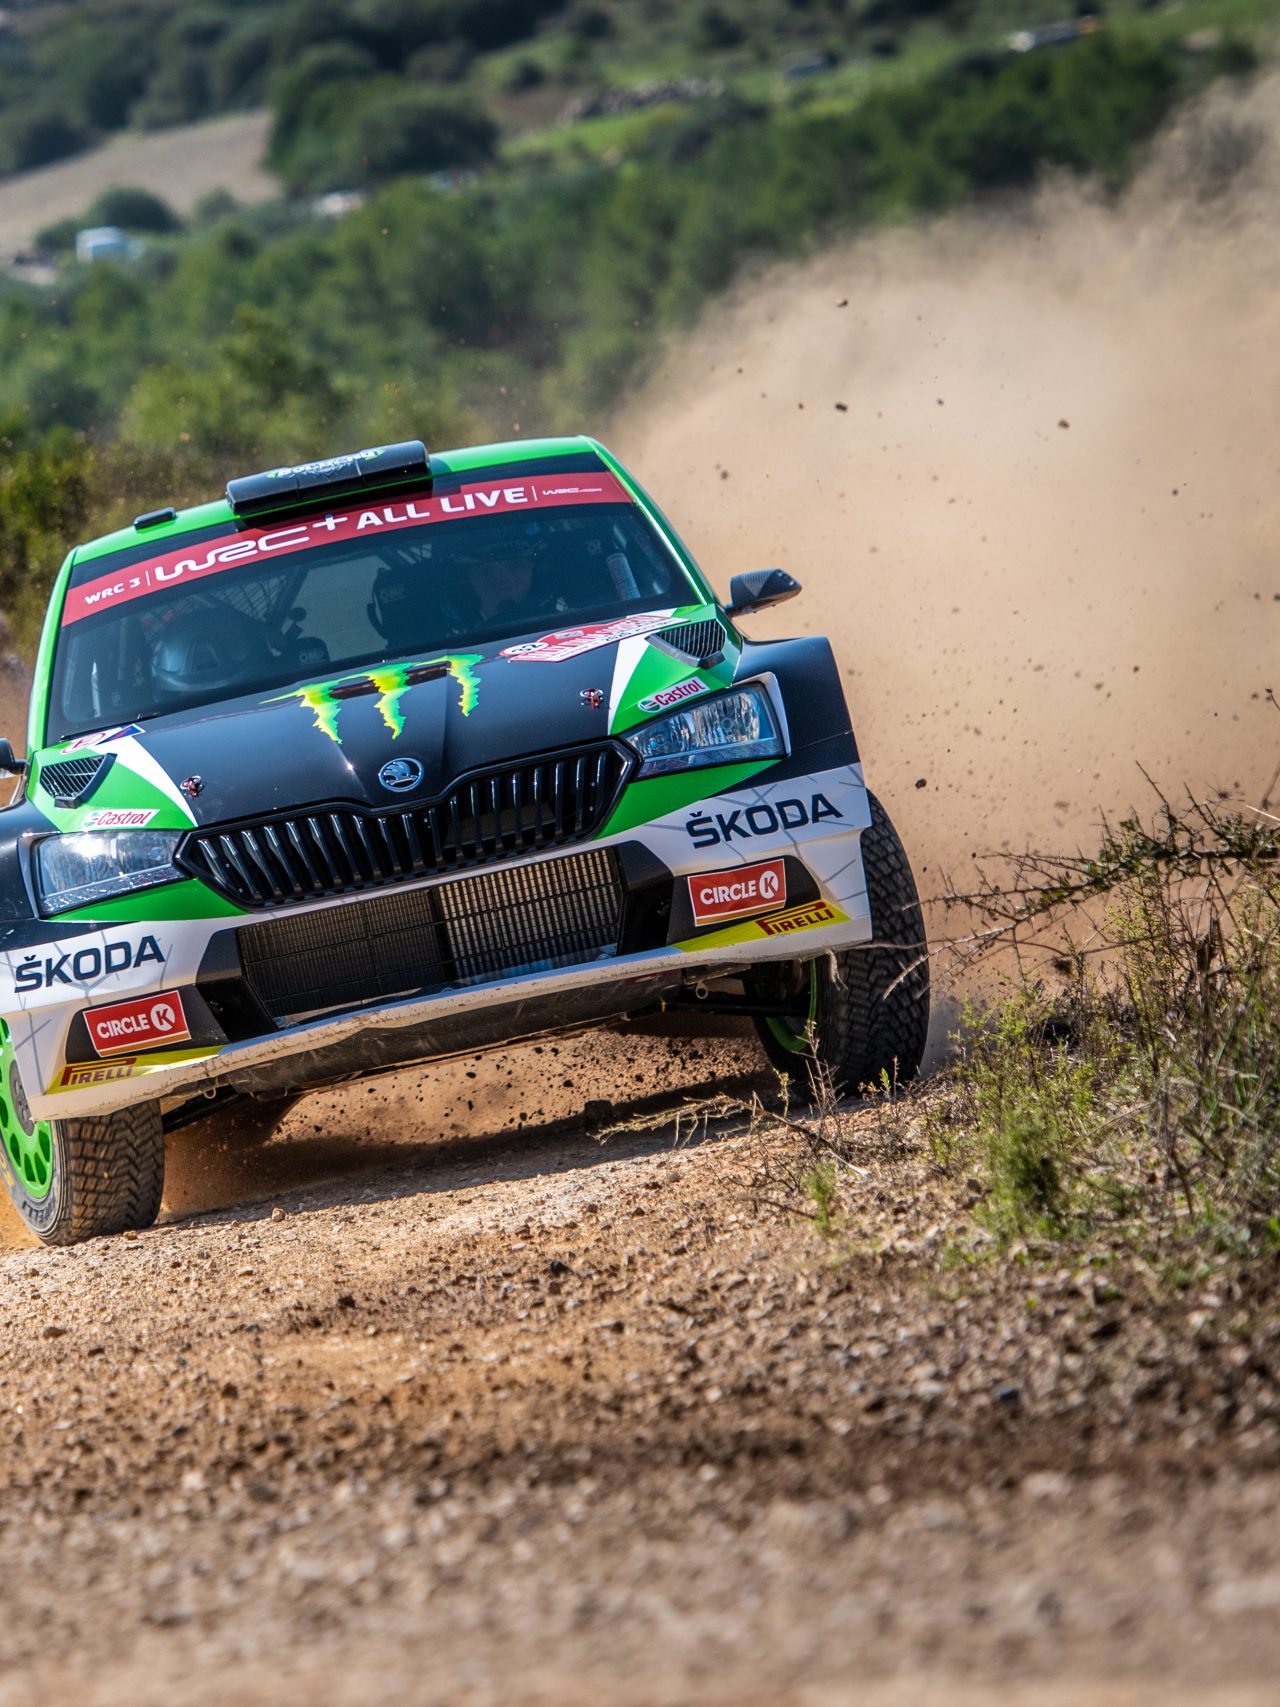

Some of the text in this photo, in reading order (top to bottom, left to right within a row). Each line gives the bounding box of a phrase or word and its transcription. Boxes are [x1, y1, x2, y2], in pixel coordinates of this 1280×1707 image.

[356, 503, 431, 530] ALL
[439, 487, 528, 513] LIVE
[84, 577, 141, 604] WRC 3
[654, 679, 705, 706] Castrol
[97, 811, 152, 826] Castrol
[685, 793, 844, 849] ŠKODA
[700, 875, 778, 905] CIRCLE K
[755, 901, 835, 936] PIRELLI
[14, 934, 166, 993] ŠKODA
[96, 1007, 174, 1039] CIRCLE K
[60, 1057, 137, 1087] PIRELLI
